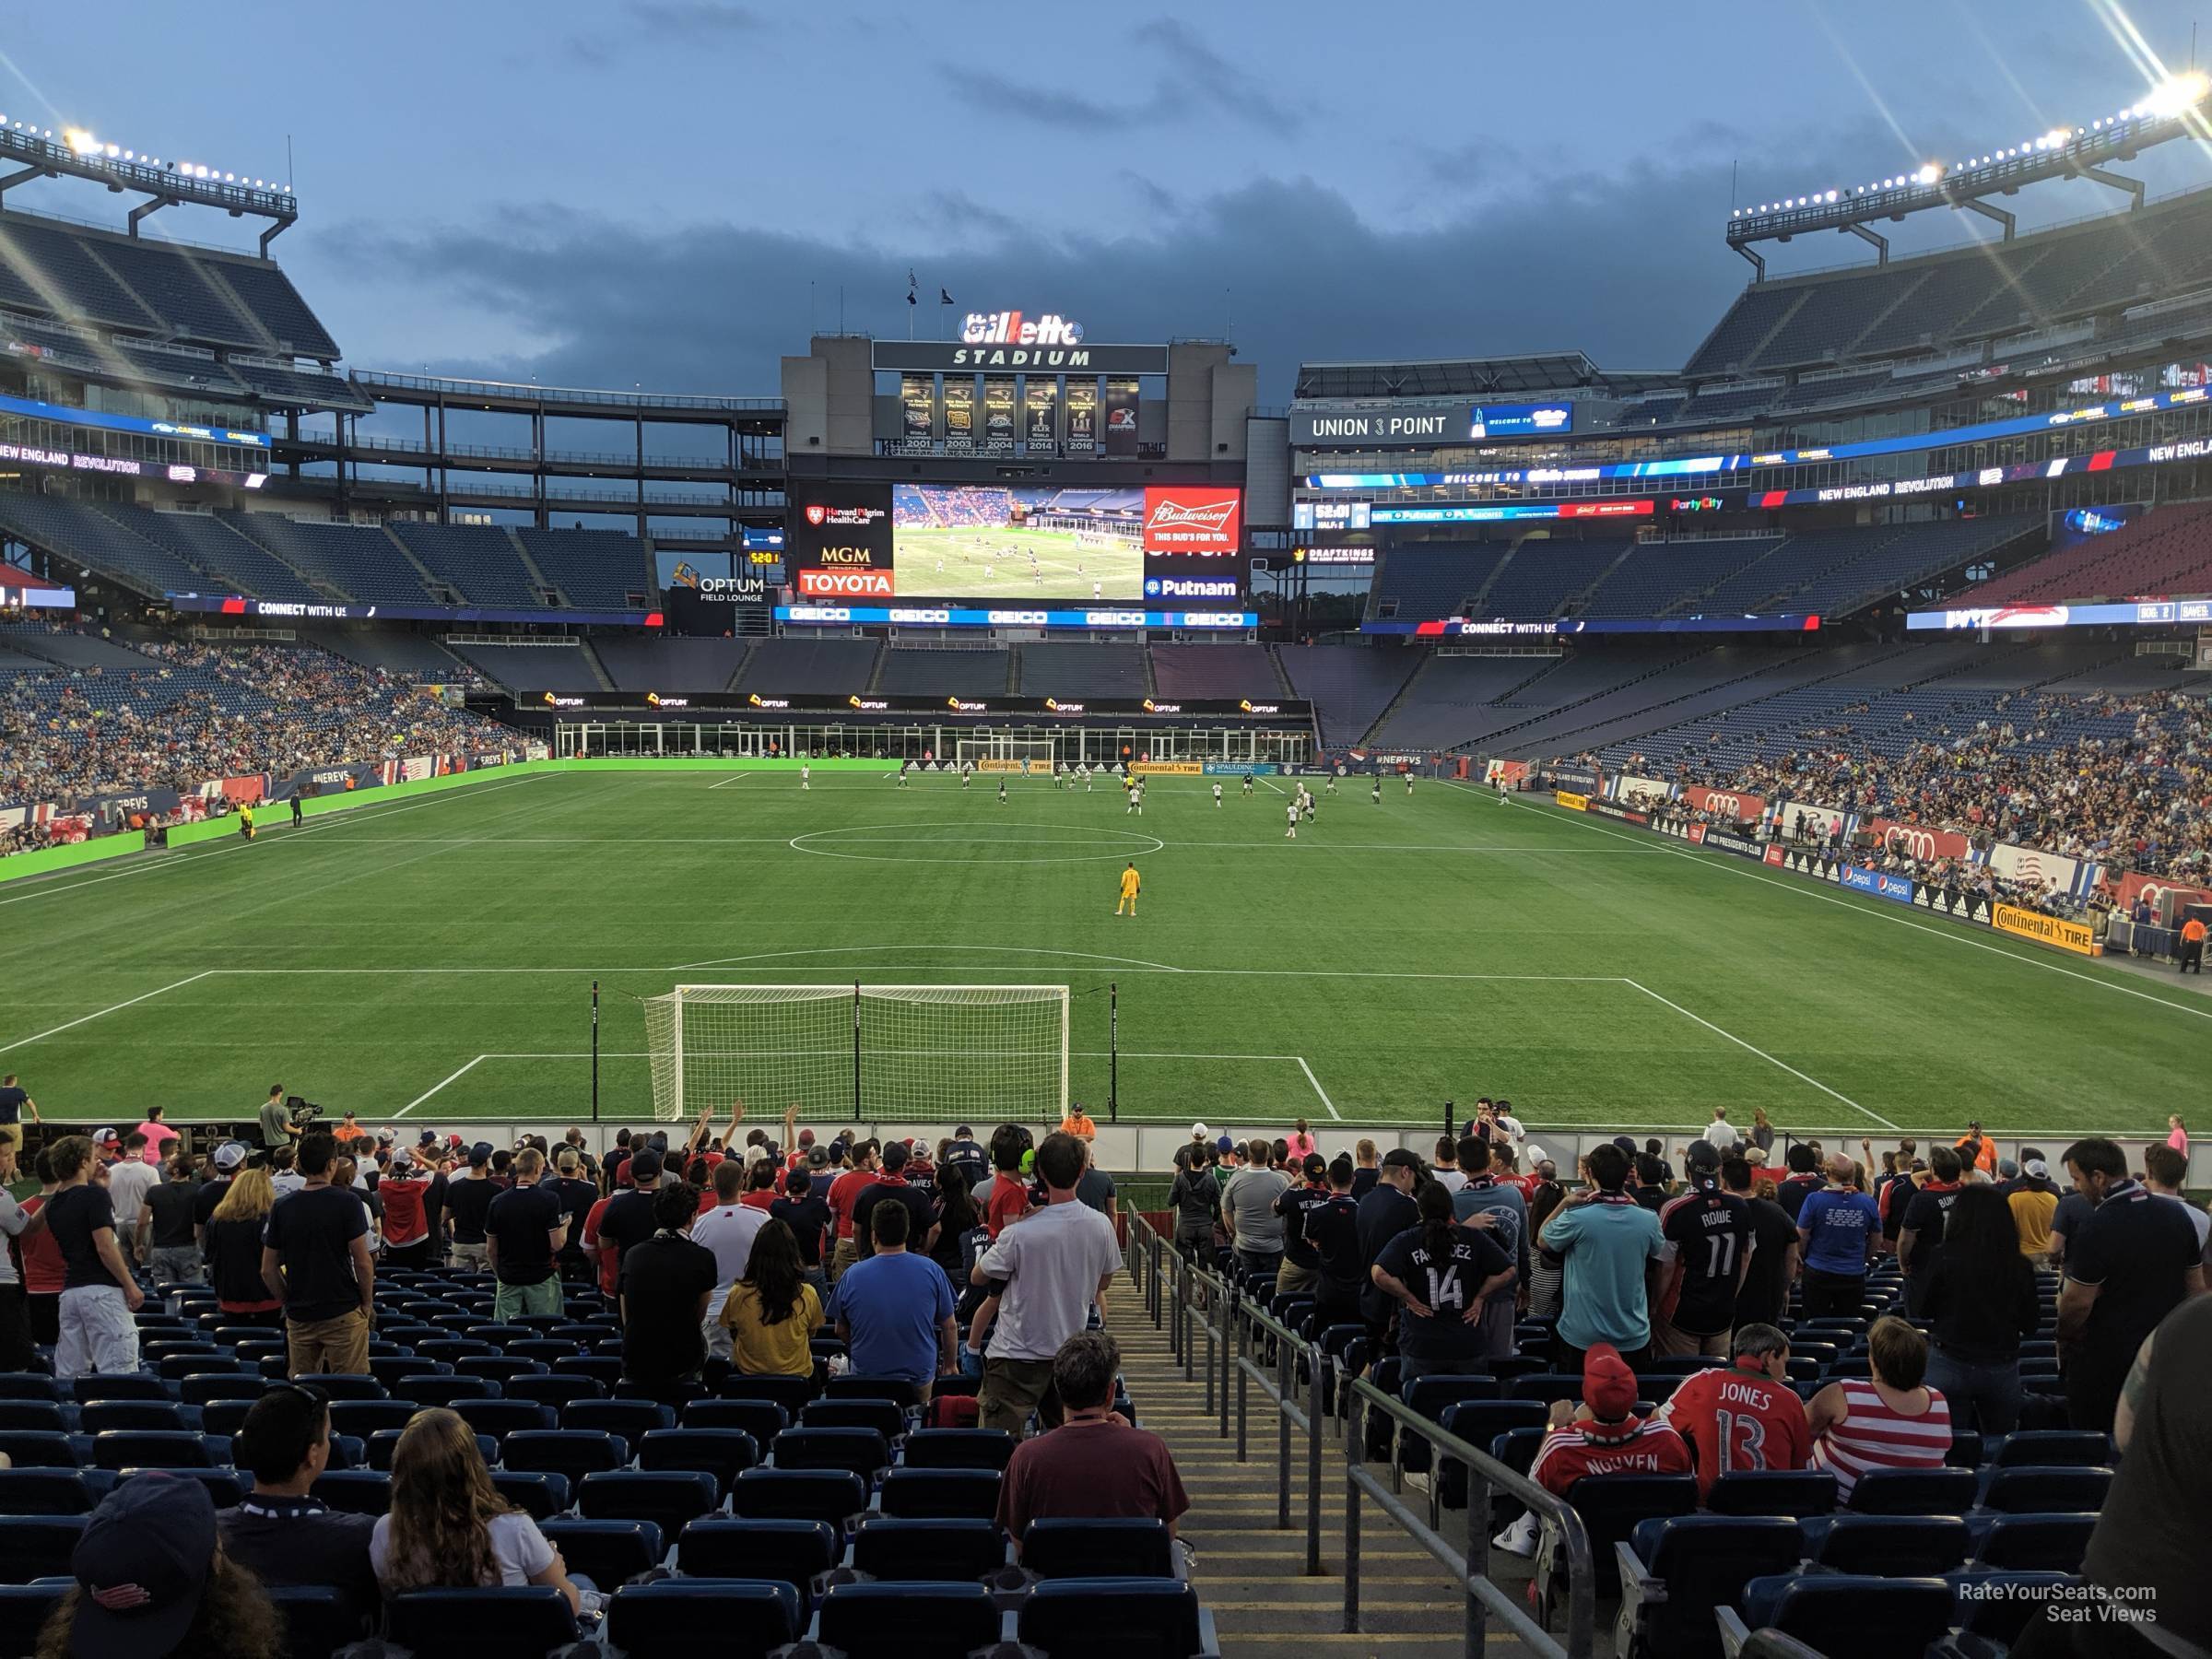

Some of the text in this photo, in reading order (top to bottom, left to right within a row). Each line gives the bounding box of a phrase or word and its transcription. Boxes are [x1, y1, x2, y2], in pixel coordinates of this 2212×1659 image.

[962, 311, 1078, 345] Gillette
[954, 349, 1089, 366] STADIUM
[1312, 417, 1446, 436] UNION POINT
[22, 448, 68, 465] ENGLAND
[74, 454, 140, 474] REVOLUTION
[2149, 447, 2173, 462] NEW
[1444, 473, 1520, 484] WELCOME TO
[1818, 477, 1954, 500] NEW ENGLAND REVOLUTION
[827, 508, 885, 518] Harvard Pilgrim
[1155, 506, 1228, 522] Budweiser
[1155, 533, 1230, 541] THIS BUD'S FOR YOU.
[820, 547, 872, 563] MGM
[1310, 548, 1374, 557] DRAFTKINGS
[700, 578, 764, 593] OPTUM
[803, 574, 891, 593] TOYOTA
[1162, 580, 1237, 596] Putnam
[700, 594, 725, 602] FIELD
[258, 602, 305, 616] CONNECT
[307, 605, 333, 617] WITH
[790, 607, 851, 620] GEICO
[889, 609, 950, 622] GEICO
[988, 611, 1048, 624] GEICO
[1086, 612, 1146, 624] GEICO
[1184, 613, 1244, 626] GEICO
[1462, 623, 1514, 633] CONNECT
[1515, 623, 1542, 633] WITH
[982, 760, 1022, 771] Continenta
[1131, 763, 1175, 772] Continental
[312, 770, 350, 783] #NEREVS
[1708, 833, 1762, 856] AUDI PRESIDENTS CLUB
[1853, 873, 1871, 886] pepsi
[1888, 882, 1908, 896] pepsi
[1913, 897, 1929, 907] adidas
[1932, 901, 1948, 912] adidas
[1952, 907, 1969, 918] adidas
[1972, 912, 1991, 924] adidas
[1996, 906, 2089, 947] Continental TIRE
[1938, 1194, 1958, 1208] BUN
[1701, 1210, 1733, 1228] ROWE
[971, 1234, 990, 1243] AGU
[1705, 1232, 1736, 1278] 11
[1426, 1265, 1463, 1311] 14
[1719, 1382, 1772, 1411] JONES
[1716, 1409, 1766, 1472] 13
